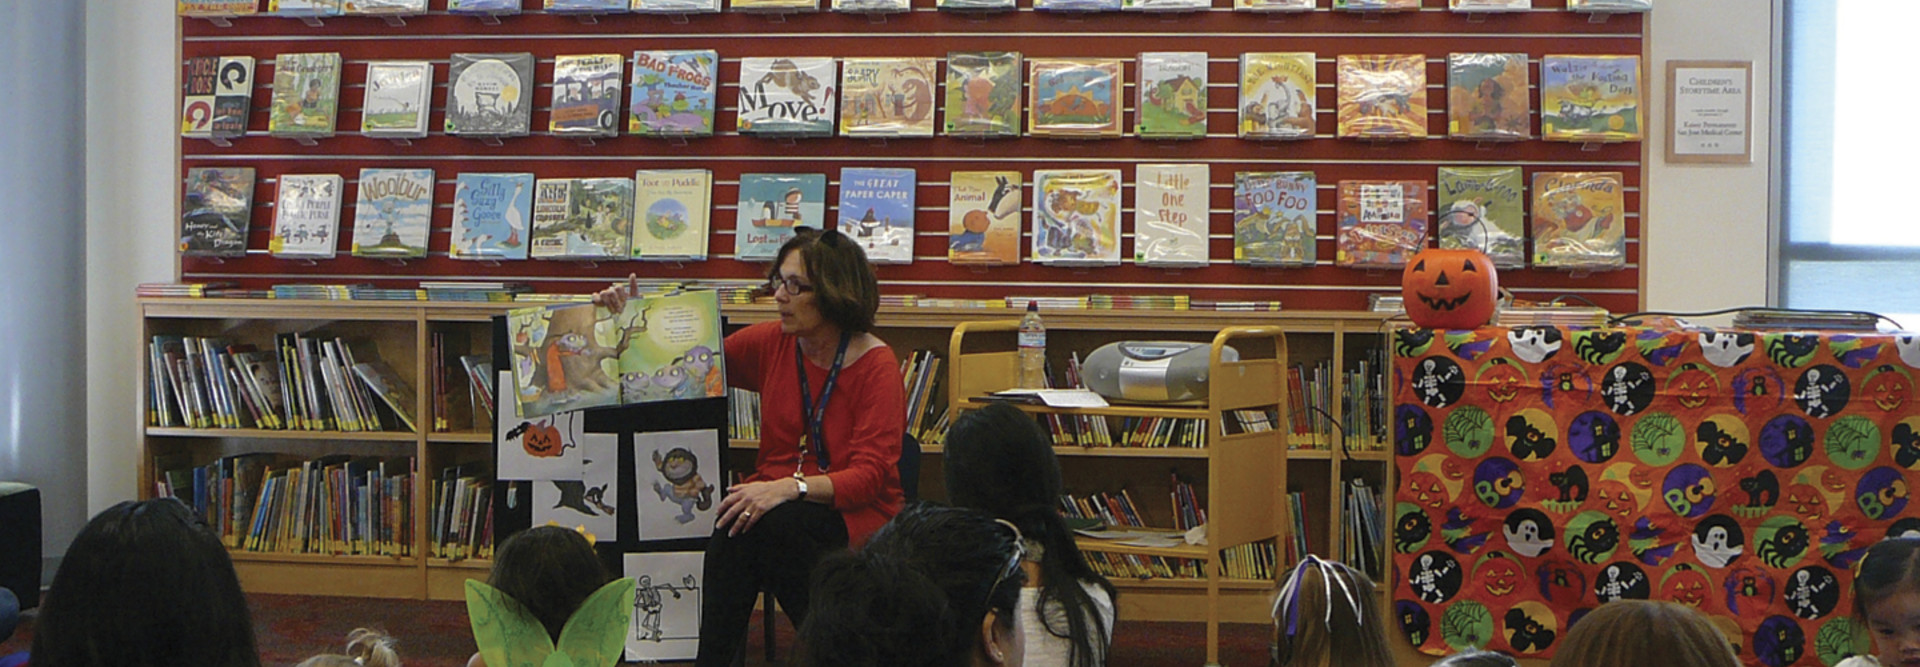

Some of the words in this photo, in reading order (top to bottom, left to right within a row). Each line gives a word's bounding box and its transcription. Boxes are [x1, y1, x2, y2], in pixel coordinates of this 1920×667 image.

[637, 53, 666, 74] BAD
[668, 63, 712, 87] FROGS
[1679, 87, 1720, 95] STORYTIME
[1722, 87, 1742, 95] AREA
[739, 79, 835, 123] Move!
[361, 172, 427, 201] Woolbur
[480, 177, 506, 199] Silly
[867, 178, 899, 188] GREAT
[1157, 172, 1190, 191] Little
[845, 190, 874, 199] PAPER
[876, 190, 909, 200] CAPER
[953, 191, 986, 202] Animal
[1244, 189, 1275, 207] FOO
[1276, 191, 1308, 211] FOO
[472, 207, 501, 227] Goose
[747, 233, 768, 244] Lost
